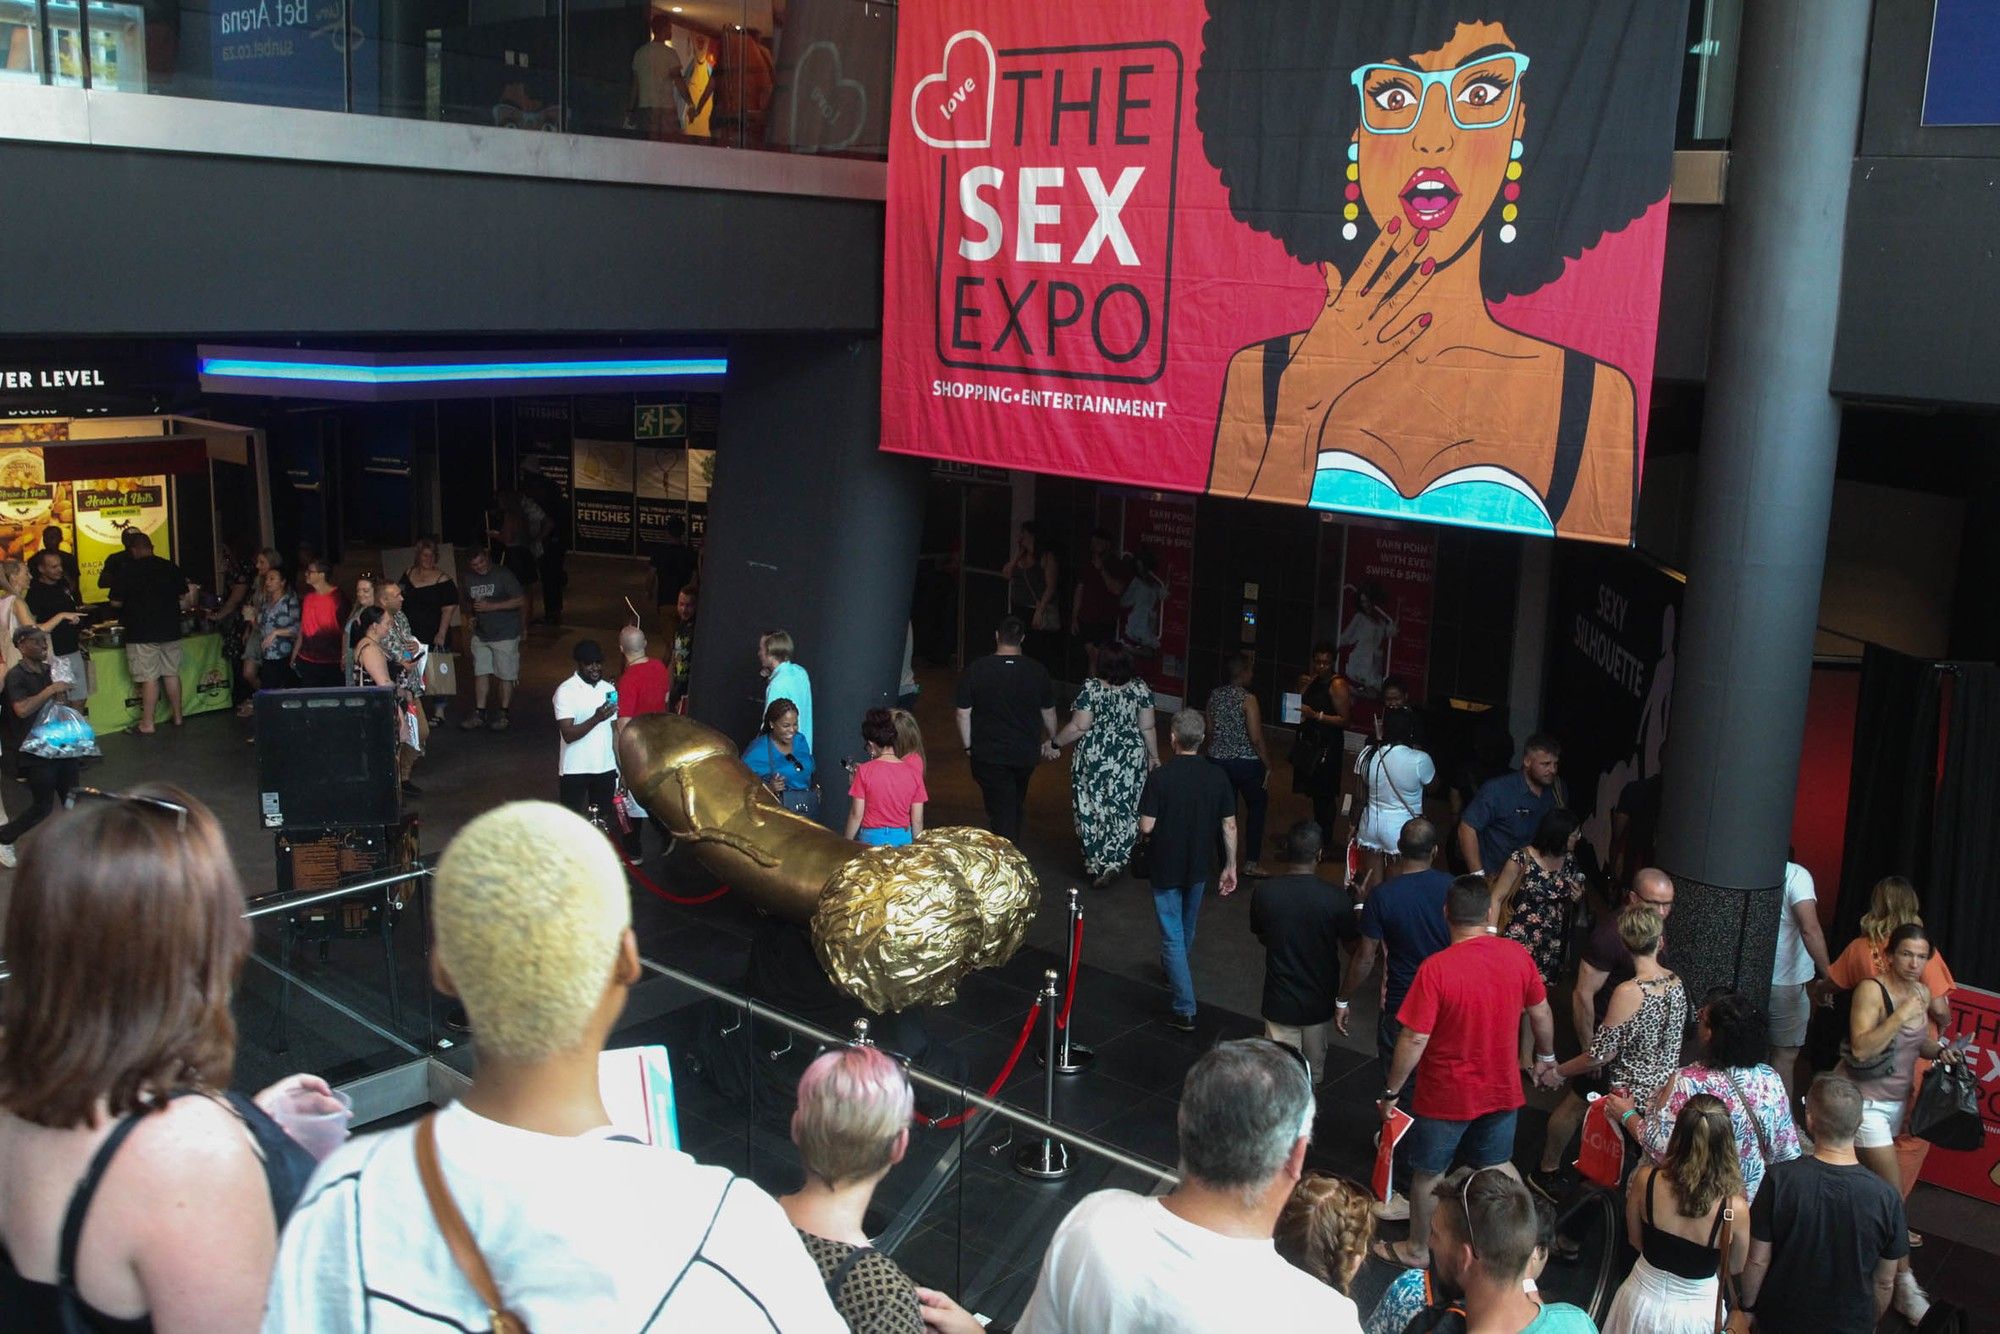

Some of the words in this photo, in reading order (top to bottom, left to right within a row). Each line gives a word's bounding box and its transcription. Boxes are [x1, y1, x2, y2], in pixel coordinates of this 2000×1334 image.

[940, 76, 976, 120] love
[1002, 64, 1154, 147] THE
[958, 165, 1145, 266] SEX
[951, 276, 1151, 363] EXPO
[0, 371, 33, 388] ER
[41, 369, 105, 388] LEVEL
[85, 494, 117, 508] House
[118, 493, 128, 506] of
[130, 492, 154, 504] Nuts
[577, 509, 631, 524] FETISHES
[1596, 583, 1628, 632] SEXY
[1574, 613, 1645, 698] SILHOUETTE
